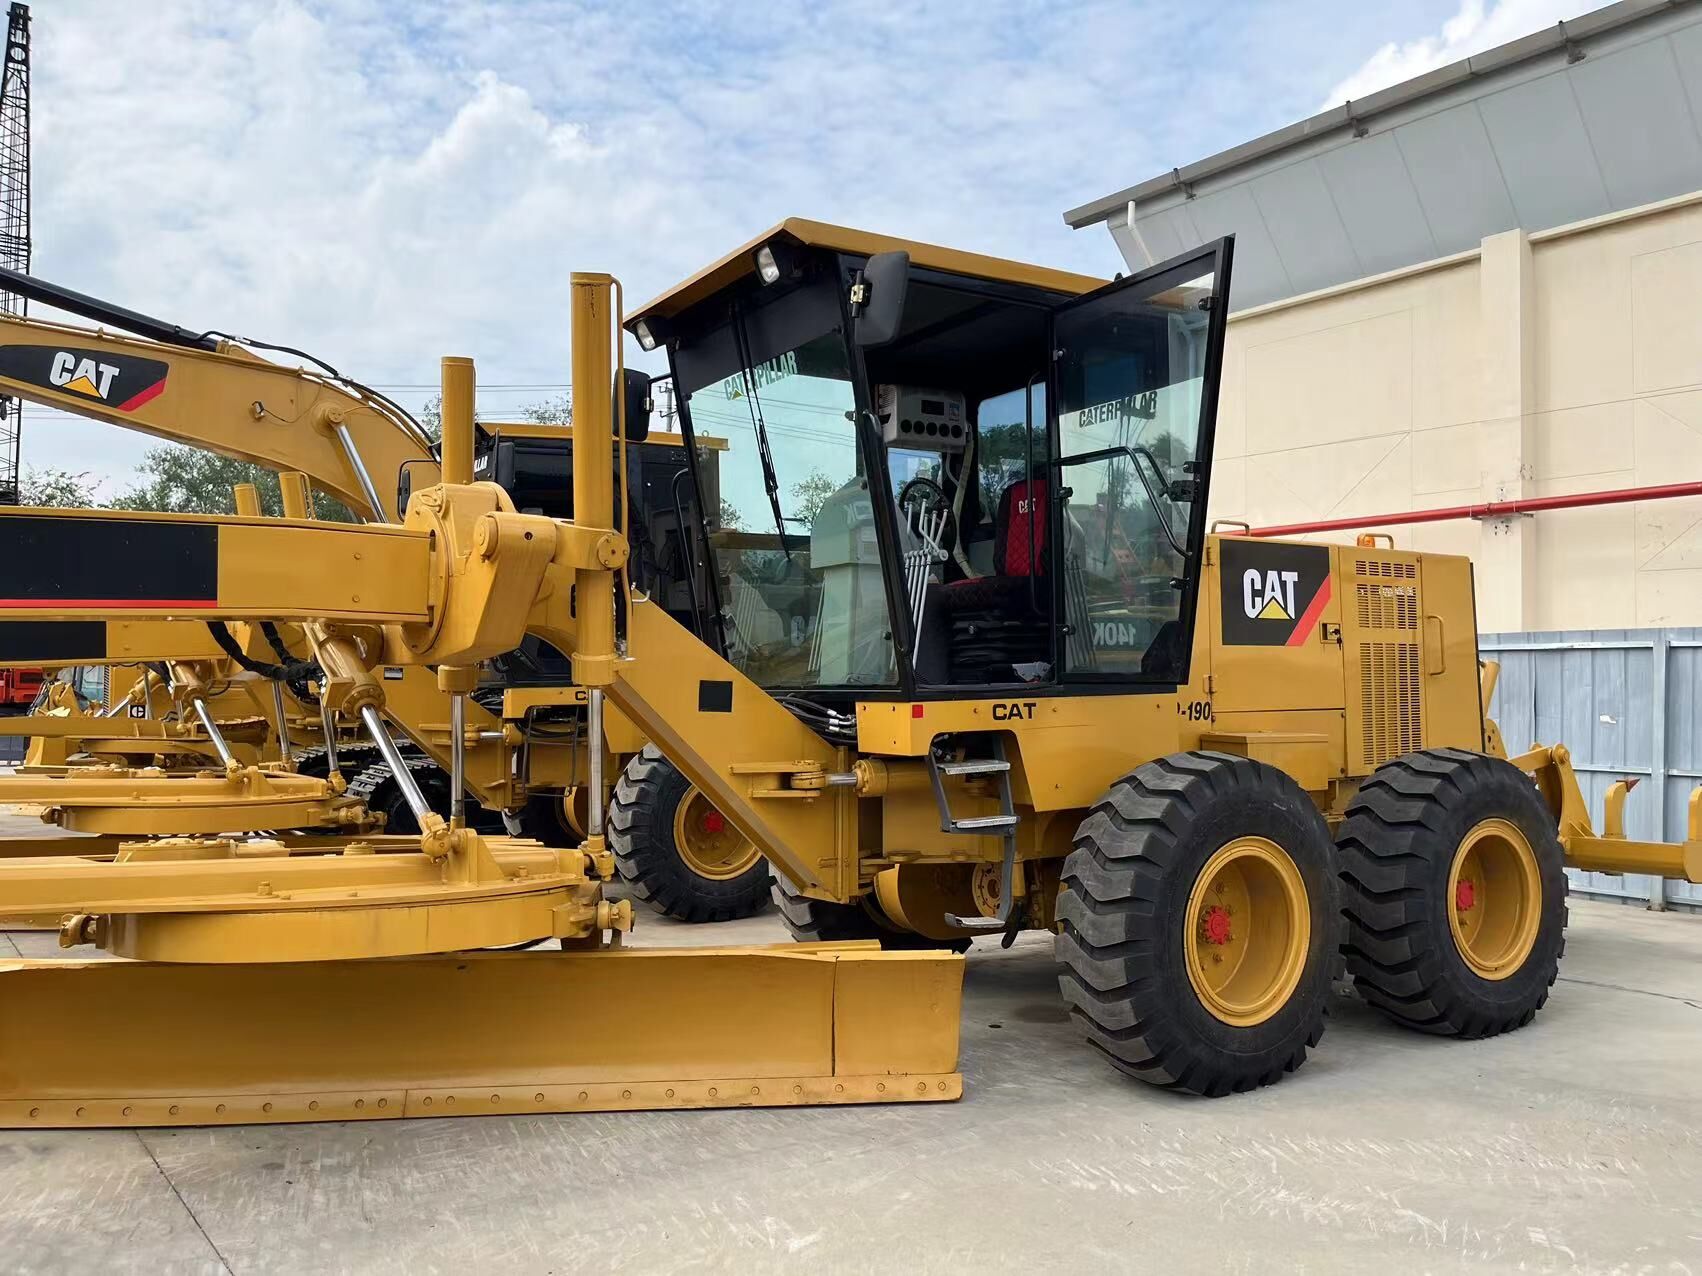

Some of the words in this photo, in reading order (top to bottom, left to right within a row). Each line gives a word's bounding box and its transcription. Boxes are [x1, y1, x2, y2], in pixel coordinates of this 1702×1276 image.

[49, 351, 120, 401] CAT
[1243, 568, 1299, 620] CAT
[992, 702, 1037, 721] CAT
